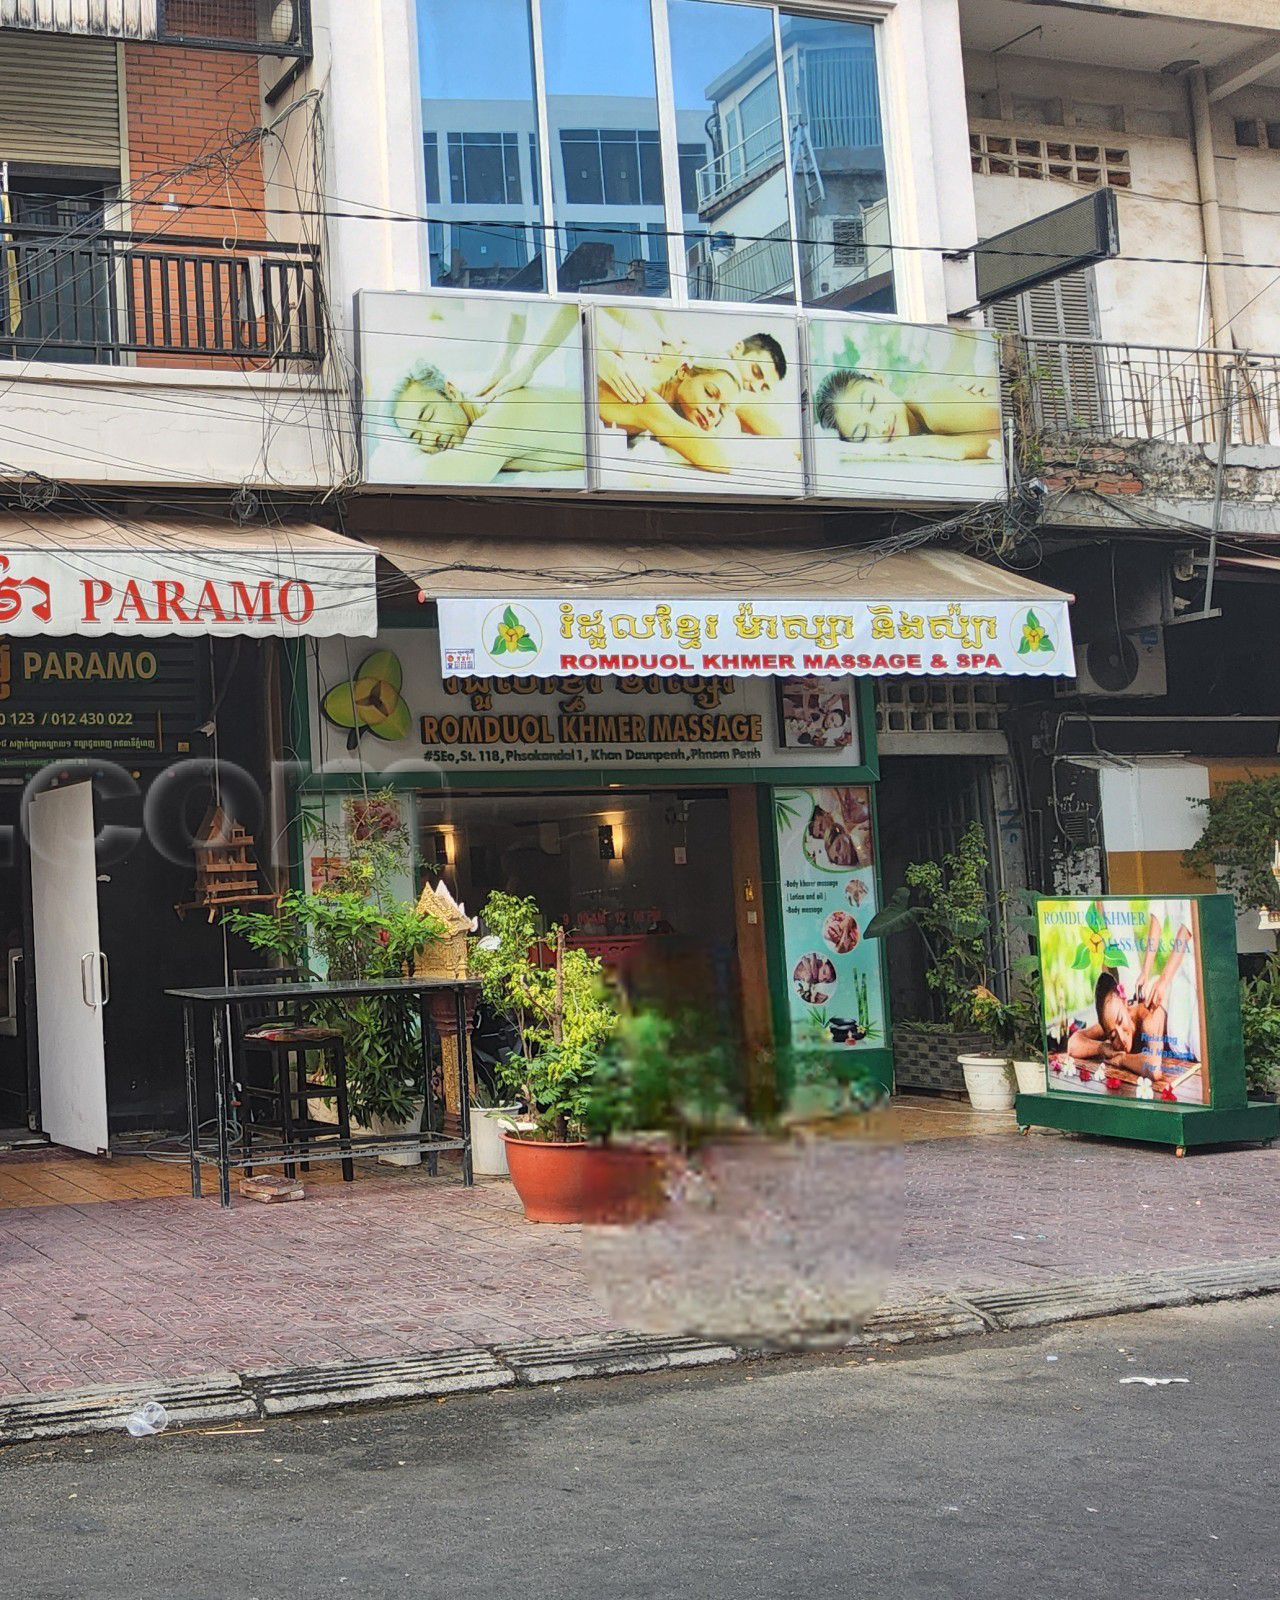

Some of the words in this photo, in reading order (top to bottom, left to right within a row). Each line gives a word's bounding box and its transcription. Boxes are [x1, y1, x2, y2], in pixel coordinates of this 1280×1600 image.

[81, 579, 315, 626] PARAMO
[23, 651, 158, 681] PARAMO
[560, 654, 694, 669] ROMDUOL
[702, 654, 795, 669] KHMER
[804, 654, 922, 669] MASSAGE
[930, 654, 949, 669] &
[956, 654, 1002, 669] SPA
[9, 712, 35, 726] 123
[51, 712, 76, 726] 012
[79, 712, 105, 726] 430
[108, 712, 133, 726] 022
[421, 714, 555, 744] ROMDUOL
[559, 714, 646, 743] KHMER
[649, 714, 764, 743] MASSAGE
[591, 748, 623, 760] Khan
[732, 747, 762, 760] Penh
[1103, 911, 1146, 926] KHMER
[1170, 937, 1191, 954] SPA
